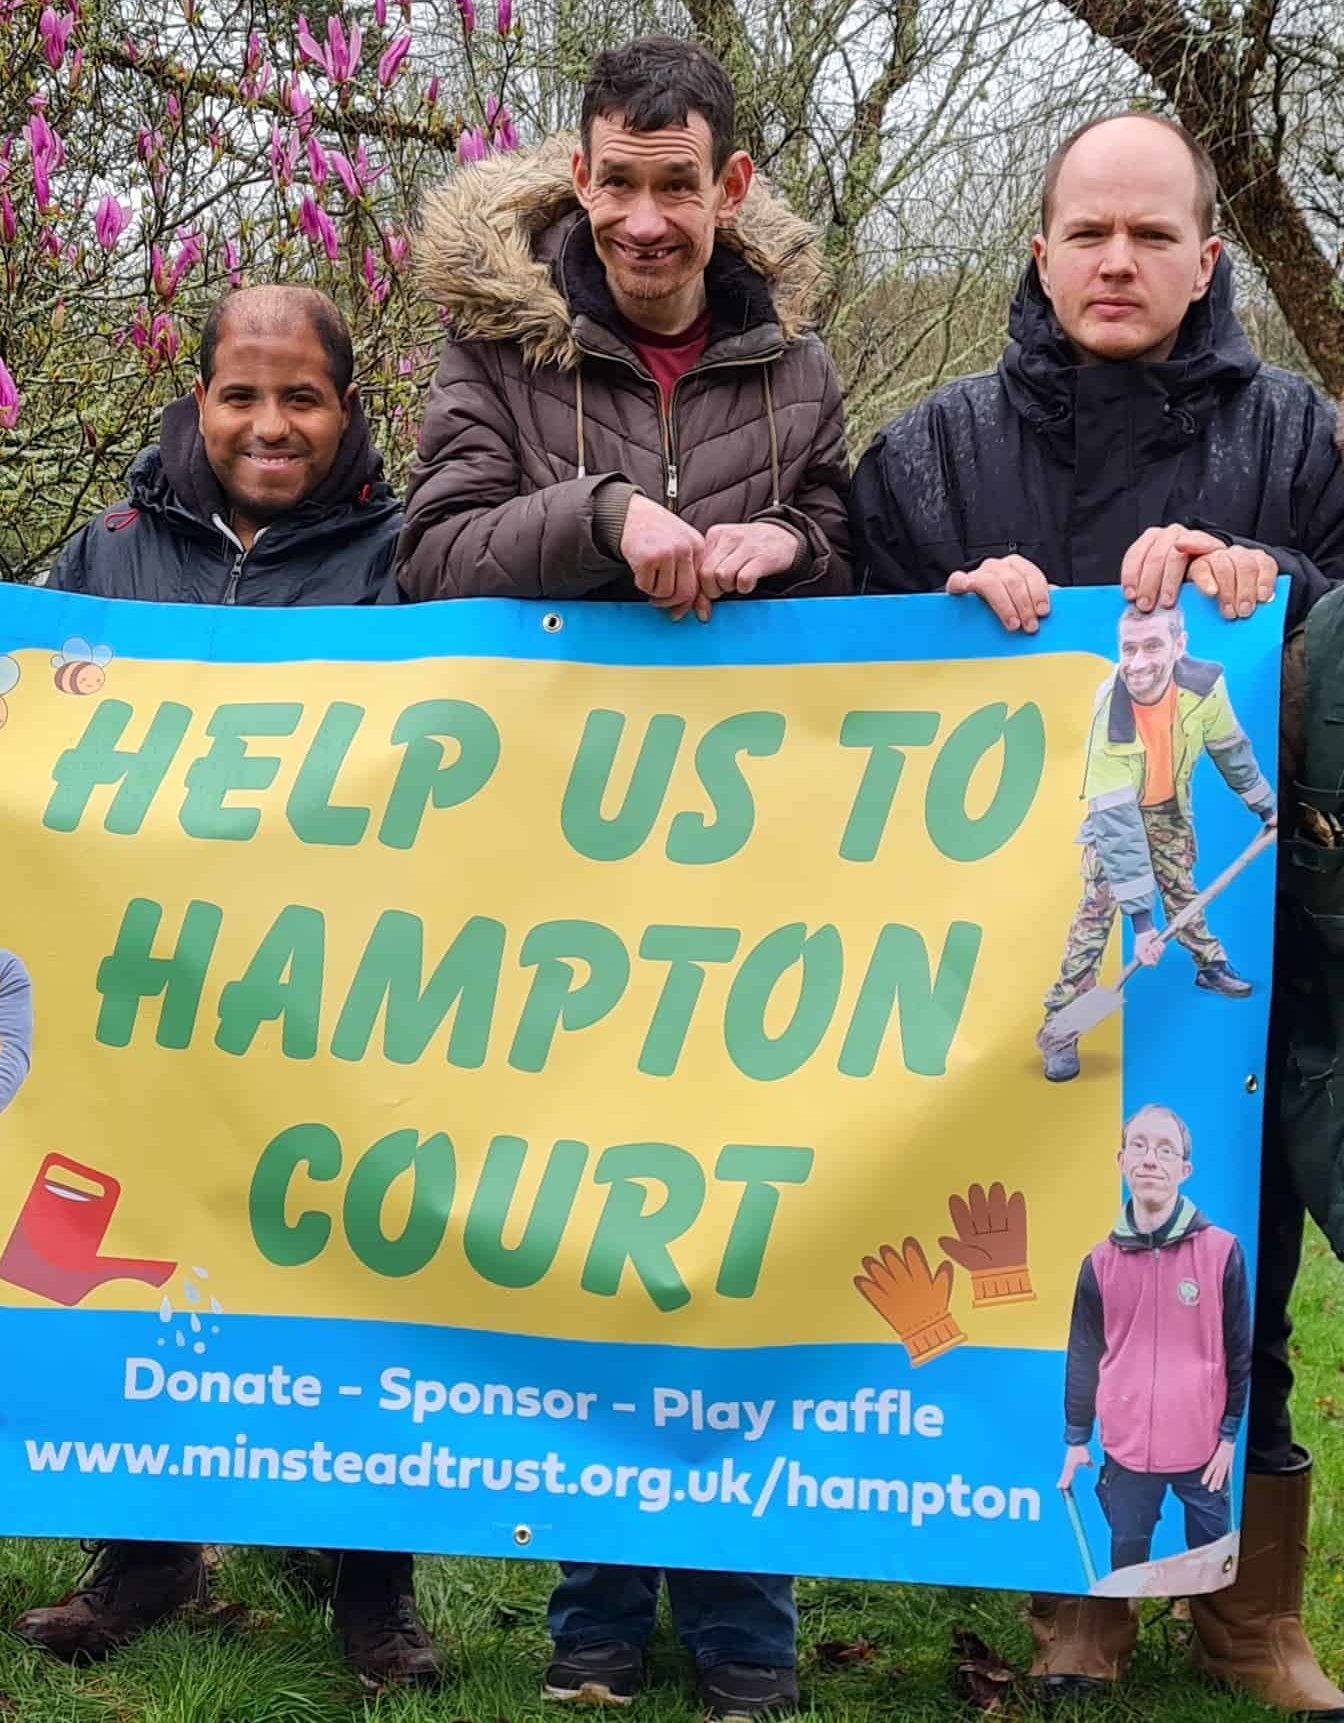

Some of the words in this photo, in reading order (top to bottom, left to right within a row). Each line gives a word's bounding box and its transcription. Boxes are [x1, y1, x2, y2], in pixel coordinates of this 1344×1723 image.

[43, 697, 501, 850] HELP
[559, 708, 787, 865] US
[838, 701, 1046, 863] TO
[95, 897, 984, 1083] HAMPTON
[248, 1122, 815, 1313] COURT
[25, 1432, 1041, 1527] www.minsteadtrust.org.uk/hampton
[124, 1357, 322, 1407] Donate
[379, 1366, 597, 1424] Sponsor
[653, 1386, 776, 1441] Play
[792, 1387, 945, 1438] raffle
